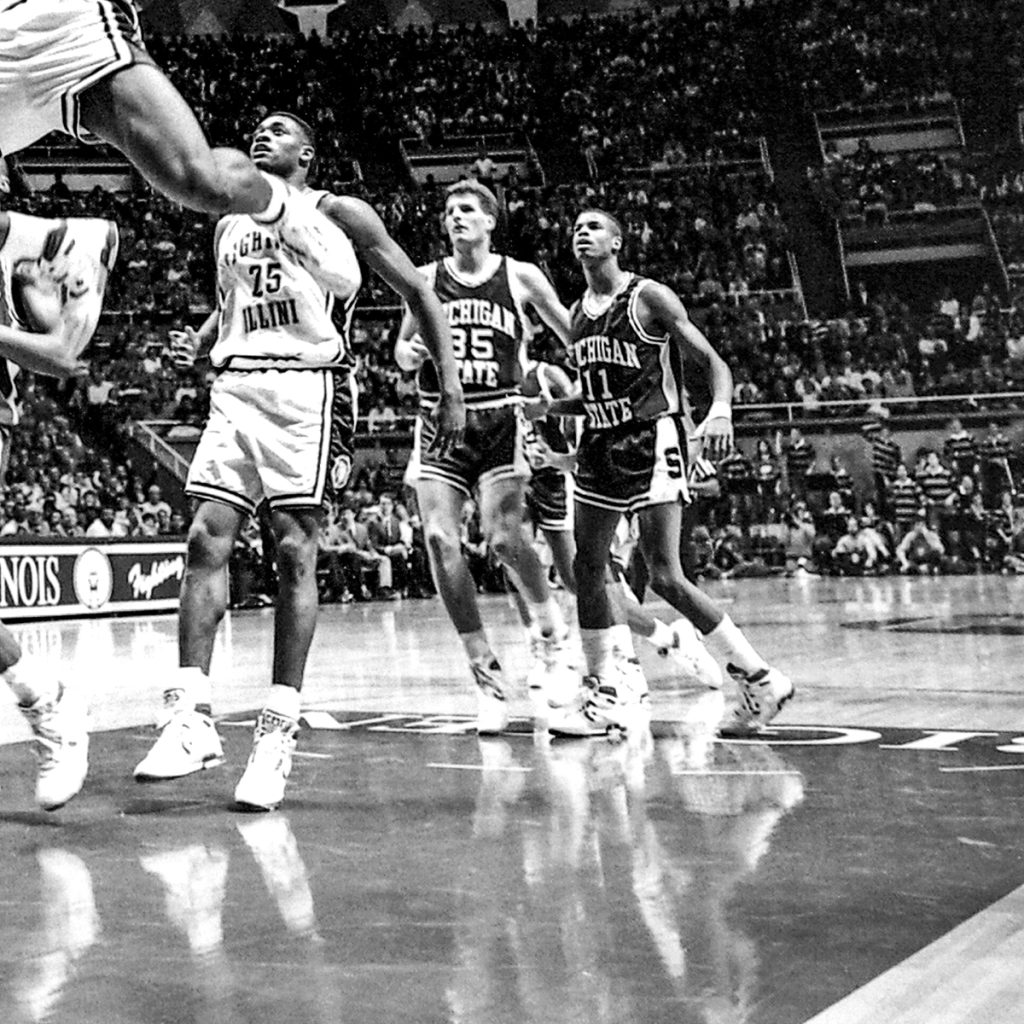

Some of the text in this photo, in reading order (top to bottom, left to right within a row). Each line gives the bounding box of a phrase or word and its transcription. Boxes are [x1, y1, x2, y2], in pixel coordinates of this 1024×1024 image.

[242, 299, 299, 334] ILLINI
[442, 298, 516, 339] CHIGAN
[575, 335, 642, 369] CHIGAN
[456, 359, 501, 388] TATE
[582, 368, 614, 401] 11
